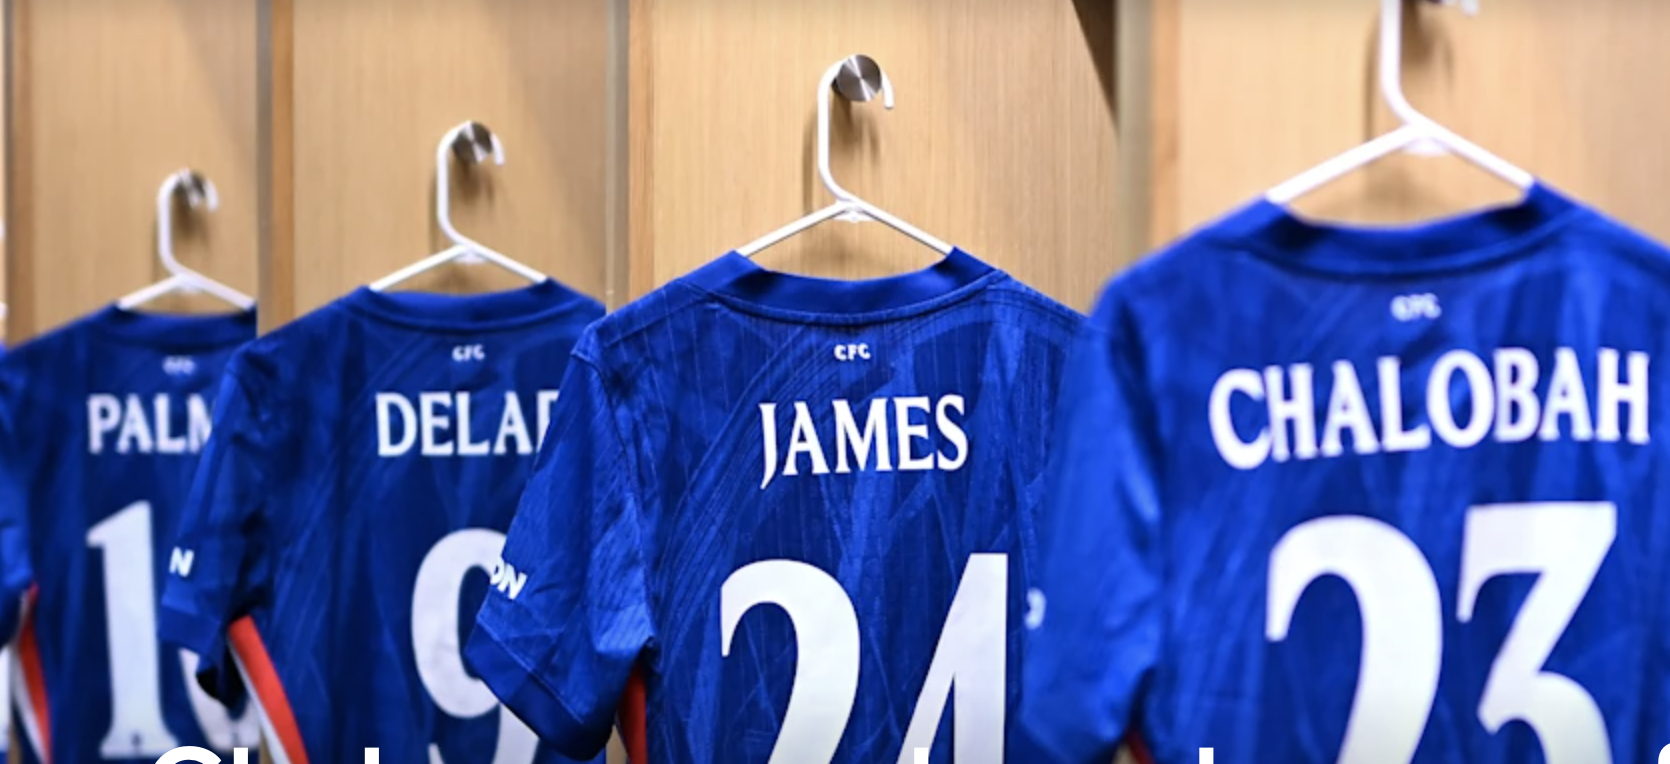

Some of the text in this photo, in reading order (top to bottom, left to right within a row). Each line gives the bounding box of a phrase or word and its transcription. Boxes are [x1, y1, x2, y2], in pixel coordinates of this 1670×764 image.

[834, 343, 871, 361] CFC
[759, 394, 968, 490] JAMES
[1209, 347, 1650, 469] CHALOBAH
[169, 547, 194, 577] N
[721, 553, 1008, 764] 24
[1266, 501, 1617, 764] 23
